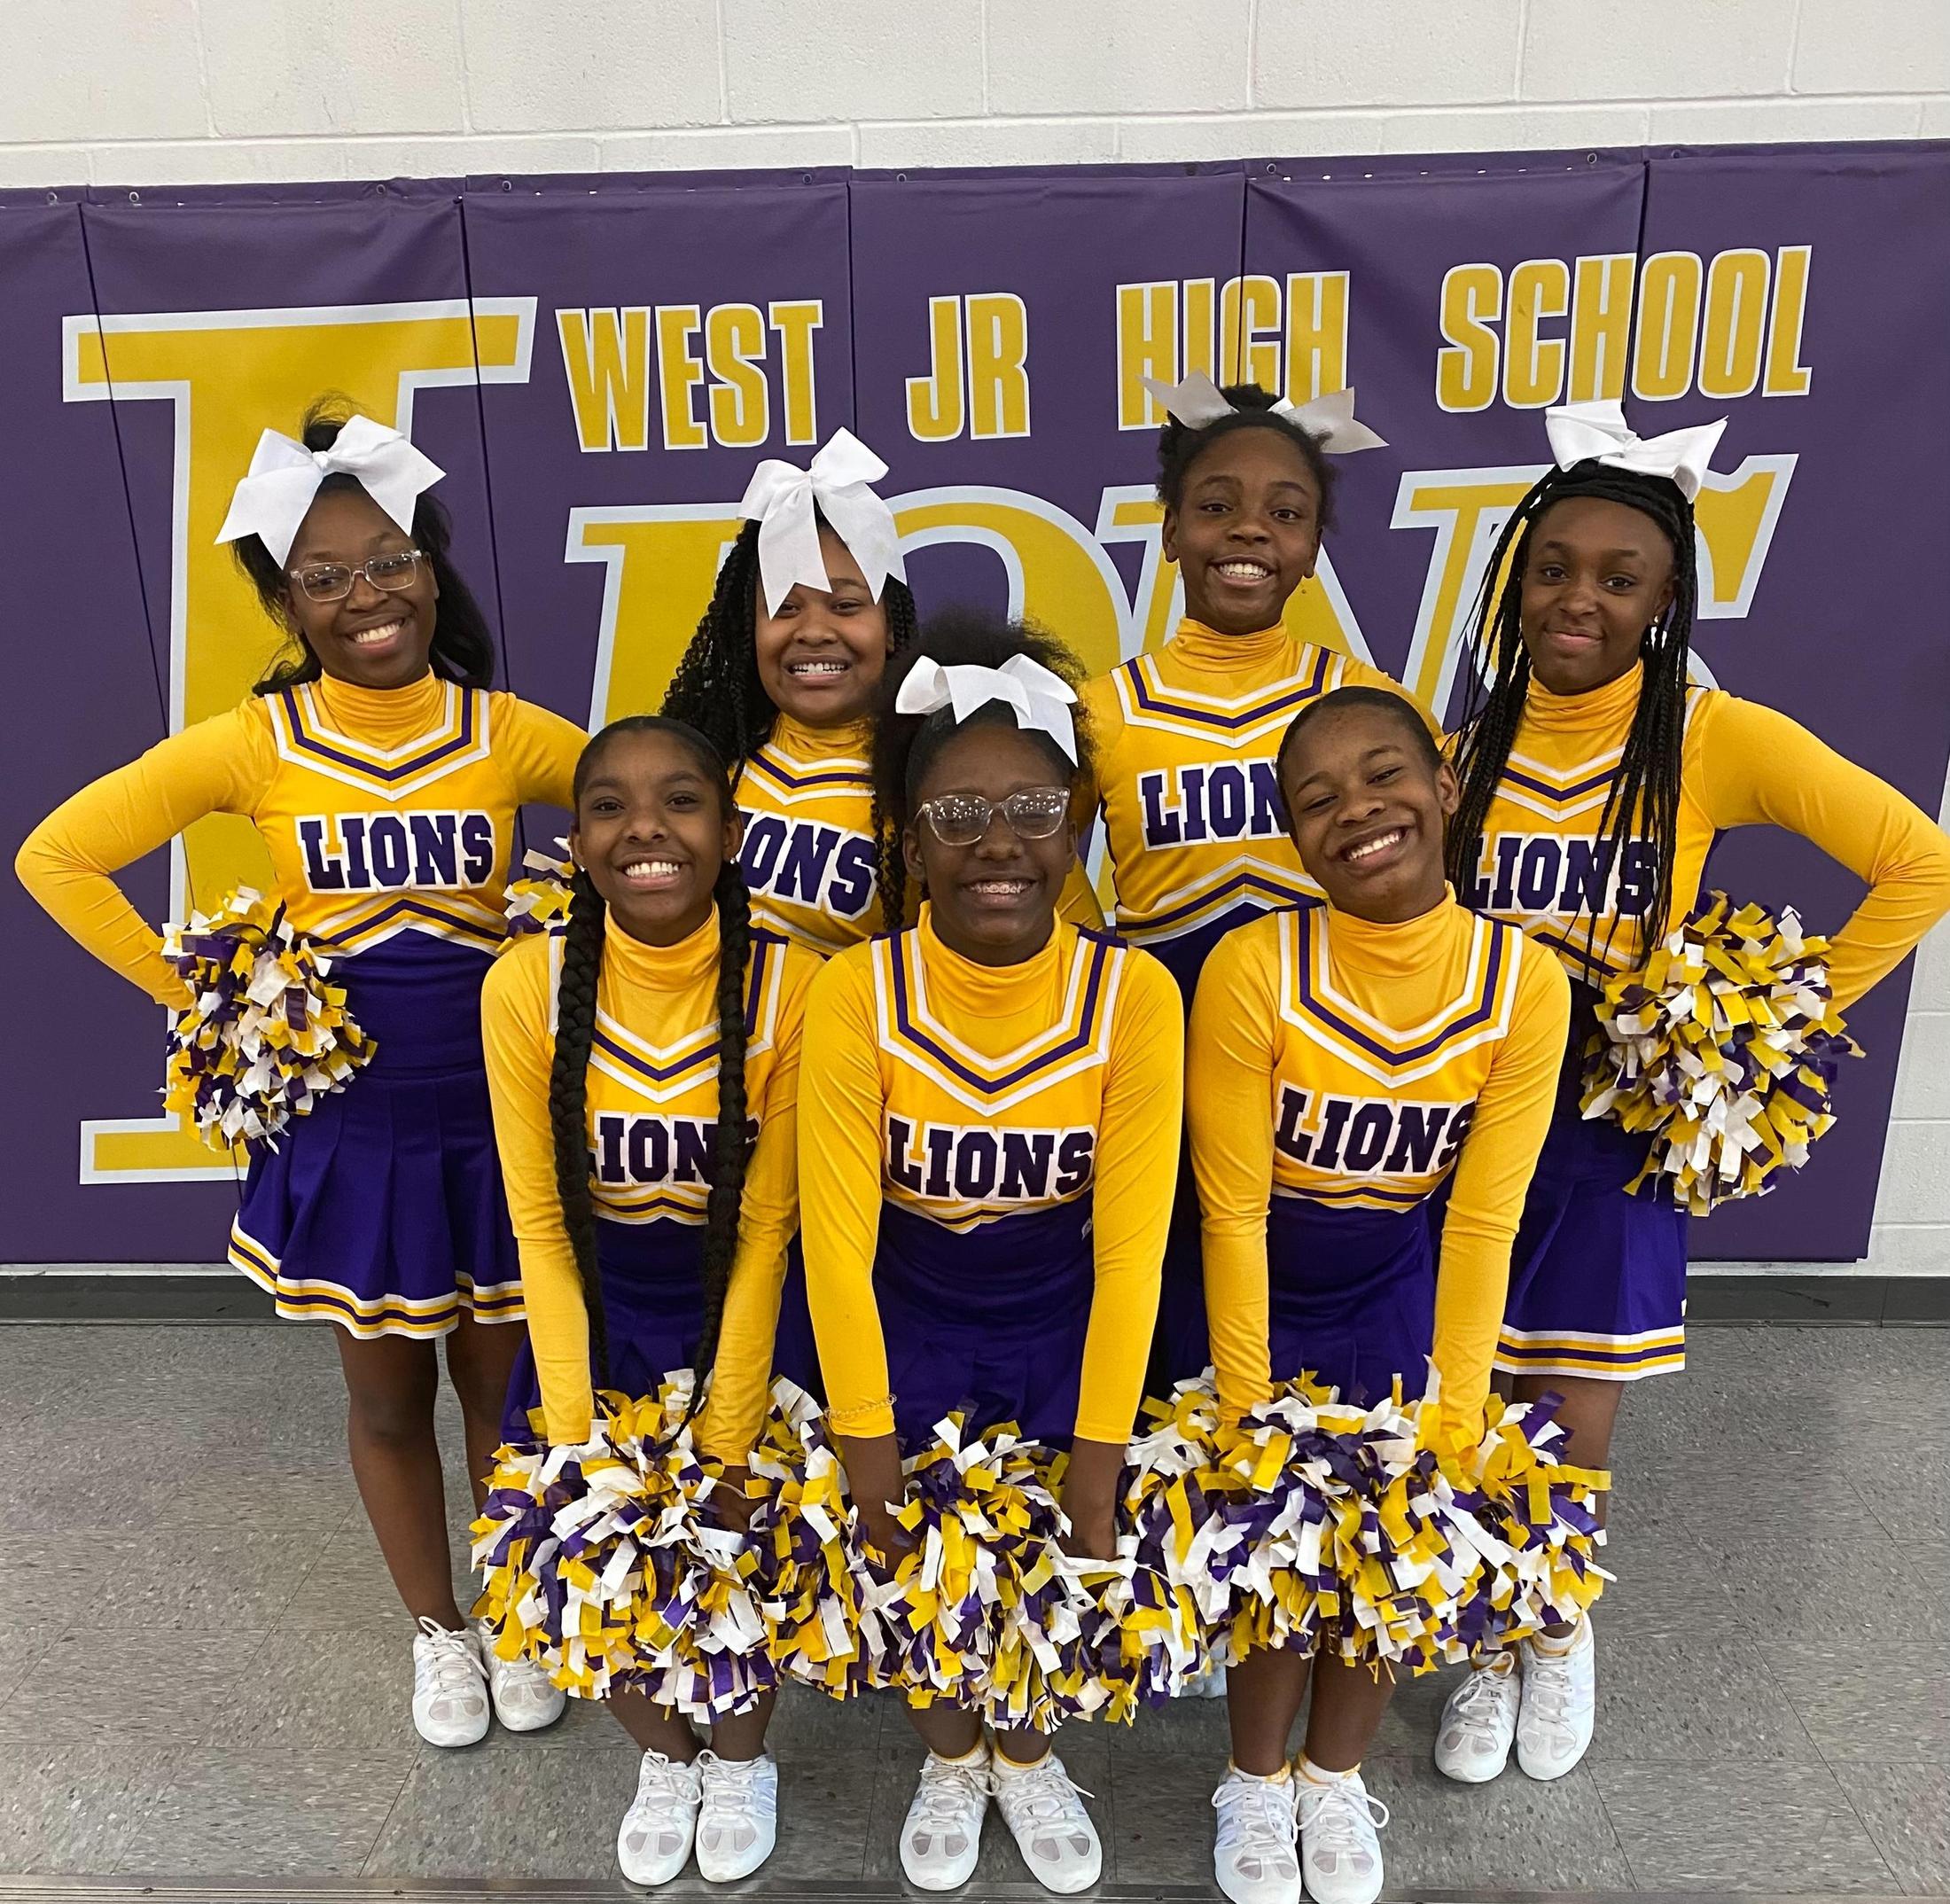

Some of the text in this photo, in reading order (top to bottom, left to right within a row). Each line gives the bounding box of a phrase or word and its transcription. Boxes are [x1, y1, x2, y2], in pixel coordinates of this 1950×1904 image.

[555, 245, 1813, 452] WEST JR HIGH SCHOOL
[1138, 759, 1293, 848] LION
[297, 810, 495, 893] LIONS
[738, 808, 879, 920] ONS
[587, 1111, 761, 1190] ION
[886, 1112, 1096, 1200] LIONS
